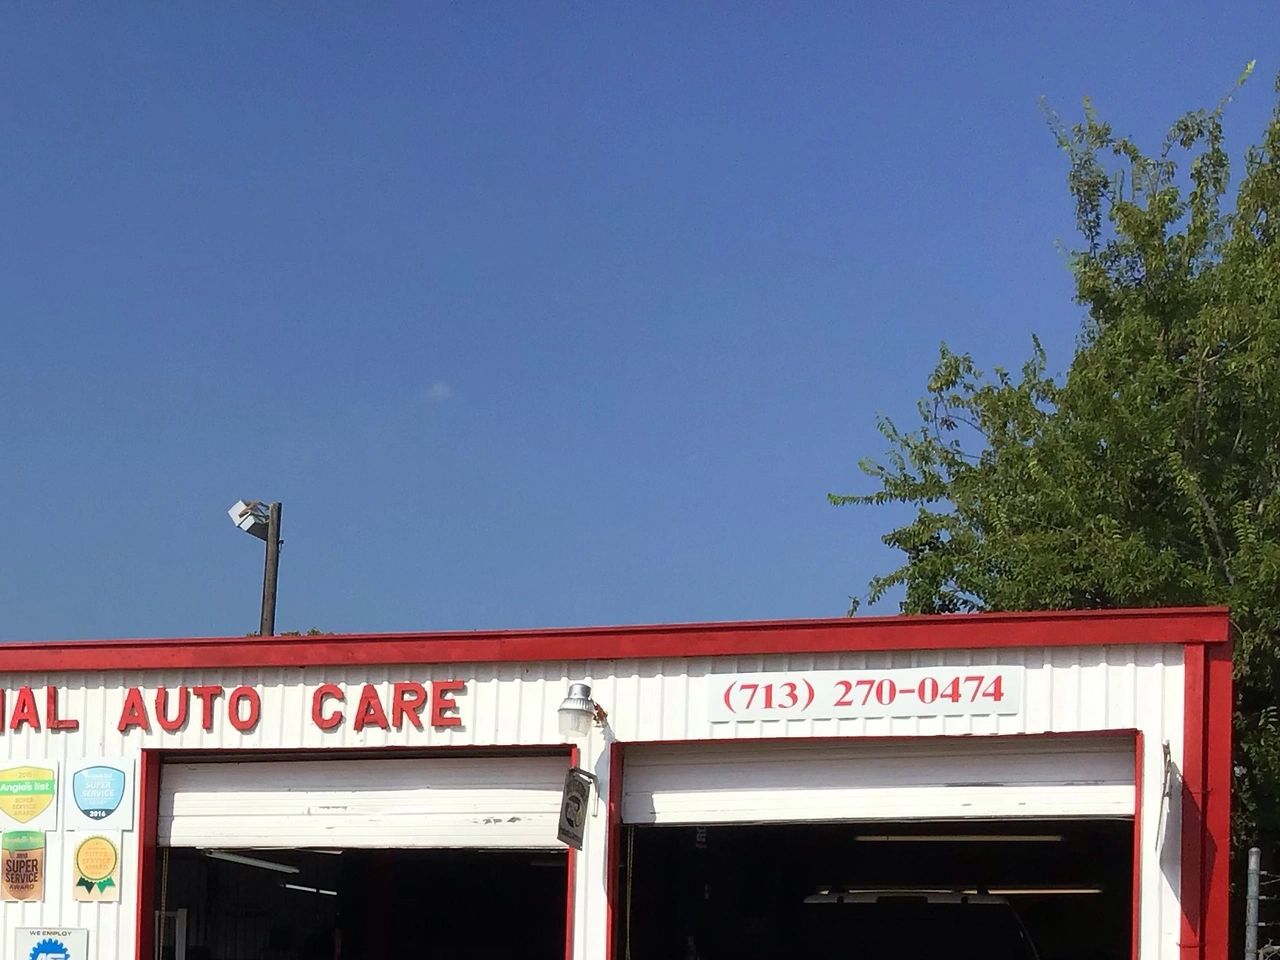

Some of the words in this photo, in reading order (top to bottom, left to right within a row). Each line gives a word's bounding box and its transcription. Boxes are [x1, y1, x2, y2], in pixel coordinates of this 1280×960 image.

[723, 679, 814, 712] (713)
[833, 674, 1005, 708] 270-0474
[118, 686, 261, 733] AUTO
[312, 680, 465, 731] CARE
[34, 782, 50, 790] list
[85, 781, 111, 789] SUPER
[81, 790, 114, 798] SERVICE
[6, 859, 38, 873] SUPER
[5, 872, 38, 883] SERVICE
